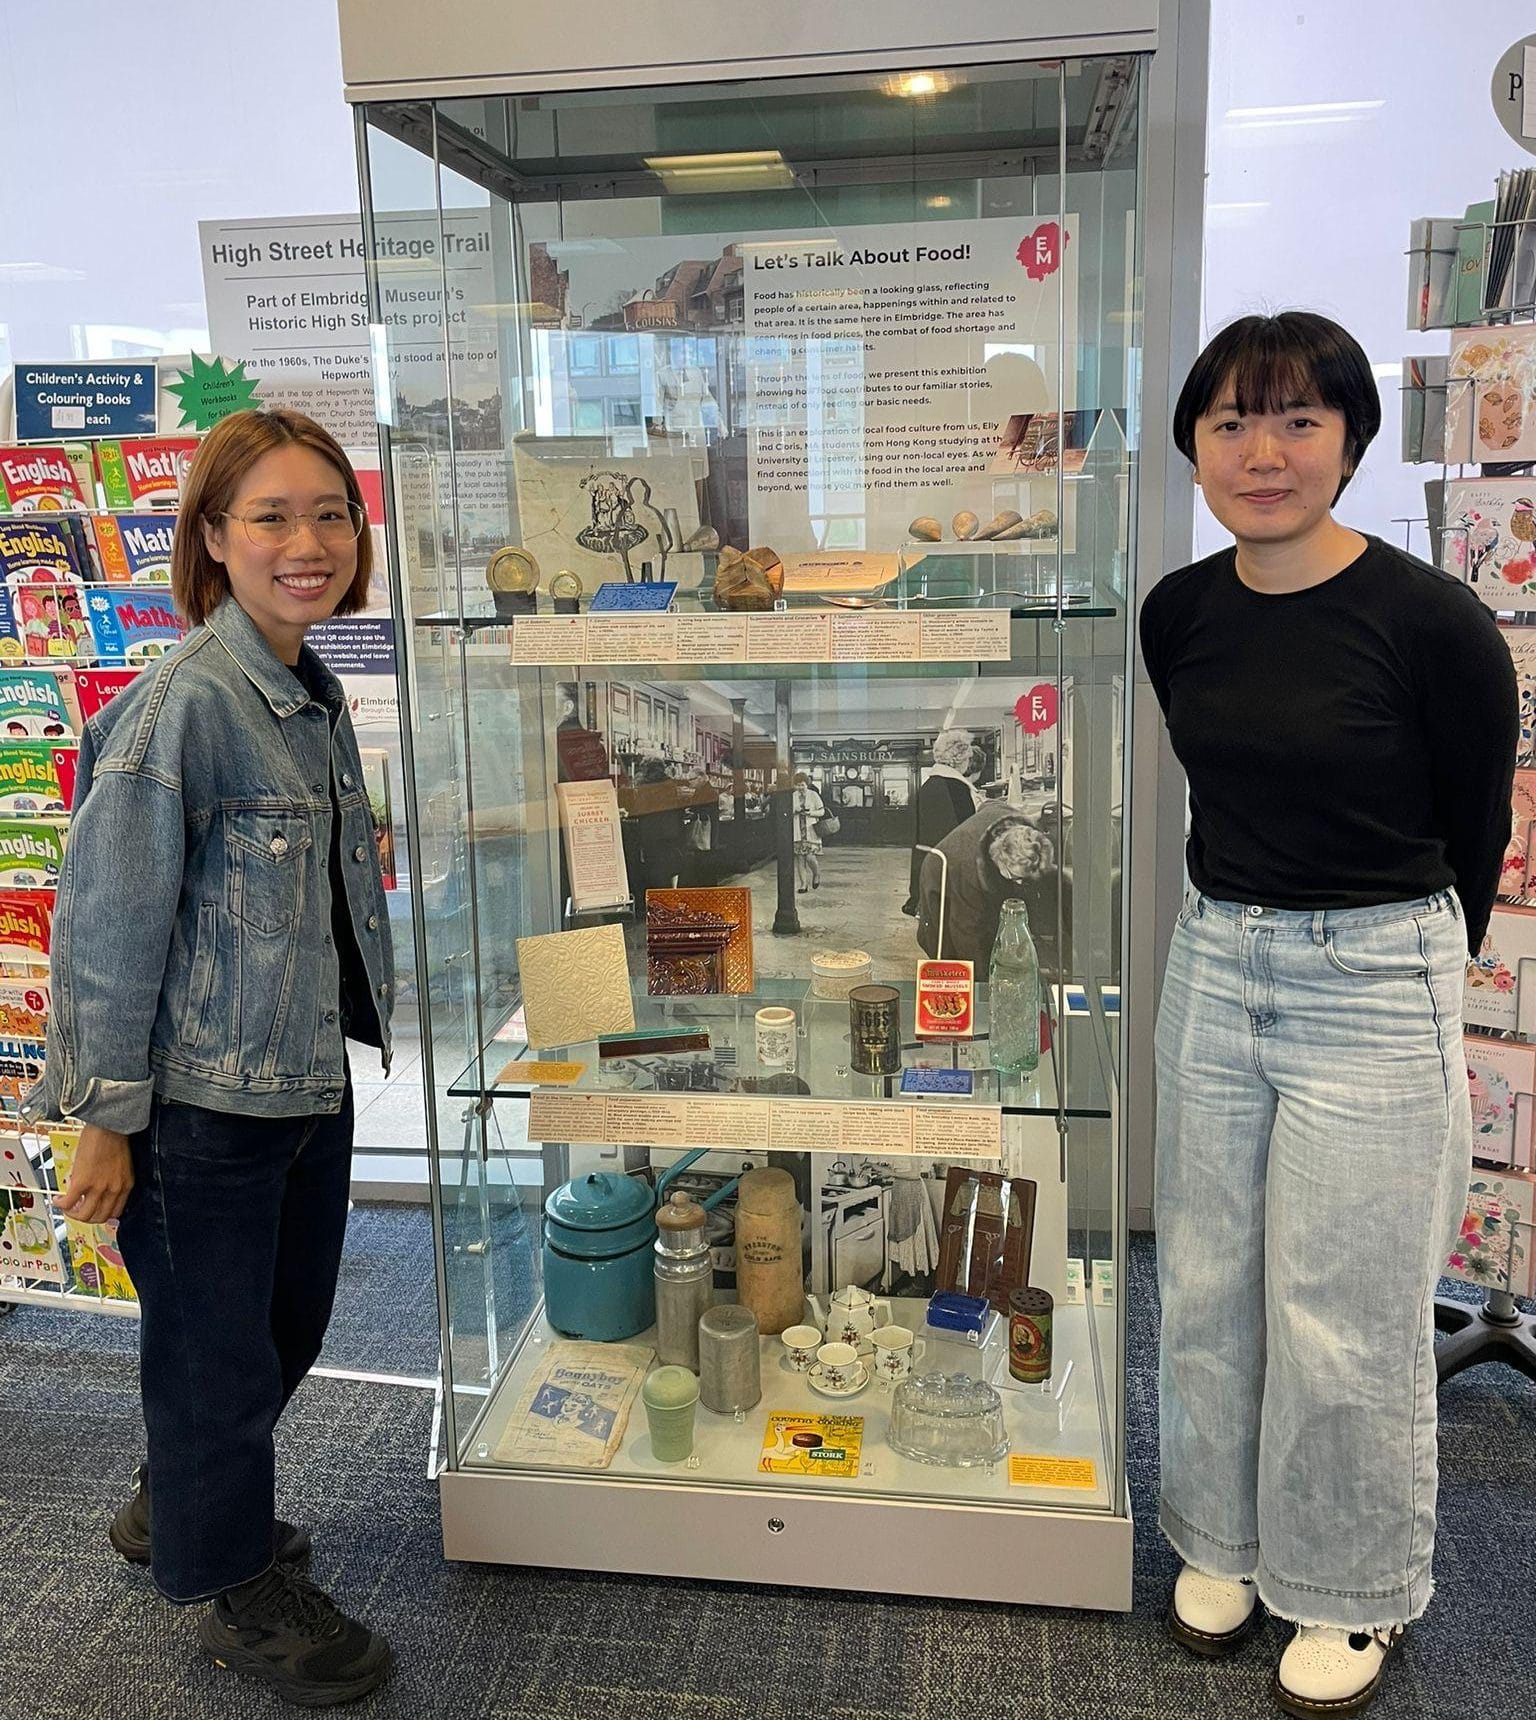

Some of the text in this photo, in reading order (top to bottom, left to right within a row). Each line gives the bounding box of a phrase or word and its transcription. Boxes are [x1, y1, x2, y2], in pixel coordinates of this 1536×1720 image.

[212, 243, 262, 268] High
[268, 240, 334, 260] Street
[442, 232, 490, 252] Trail
[754, 244, 970, 270] Let's Talk About Food!
[1461, 258, 1482, 272] LOV
[247, 287, 464, 308] Part of Elmbridg Museum's
[754, 282, 990, 300] Food looking glass, reflecting
[754, 306, 784, 316] people
[786, 304, 796, 312] of
[805, 303, 837, 312] certain
[864, 300, 917, 311] happenings
[920, 298, 948, 306] within
[950, 296, 968, 304] and
[970, 296, 1004, 304] related
[1006, 294, 1016, 302] to
[249, 316, 306, 330] Historic
[312, 314, 346, 331] High
[350, 312, 408, 326] Stets
[636, 316, 678, 328] COUSINS
[754, 320, 772, 328] that
[807, 318, 815, 326] is
[817, 317, 832, 326] the
[884, 314, 892, 322] in
[894, 312, 944, 322] Elmbridge.
[812, 330, 832, 339] food
[882, 327, 918, 336] combat
[920, 326, 929, 334] of
[932, 326, 952, 334] food
[954, 324, 995, 334] shortage
[998, 323, 1016, 331] and
[260, 350, 498, 368] the 1960s, The Duke's stood at top of
[322, 370, 370, 381] Hepworth
[884, 370, 919, 379] present
[922, 368, 938, 376] this
[940, 366, 986, 376] exhibition
[26, 372, 143, 388] Children's Activity &
[202, 380, 235, 390] Children's
[922, 382, 957, 390] familiar
[960, 380, 992, 390] stories,
[38, 392, 131, 408] Colouring Books
[302, 390, 313, 398] top
[326, 388, 360, 397] Hepworth
[876, 396, 932, 406] basic needs.
[86, 414, 111, 425] each
[886, 422, 965, 433] food culture from
[886, 436, 978, 448] Hong Kong studying
[757, 456, 800, 465] University
[903, 452, 944, 460] non-local
[2, 457, 72, 485] English
[758, 470, 774, 478] find
[872, 466, 892, 474] food
[894, 465, 902, 474] in
[905, 464, 920, 473] the
[922, 464, 944, 472] local
[968, 464, 985, 472] and
[758, 478, 954, 492] beyond, find them well.
[0, 532, 68, 558] English
[124, 527, 173, 556] Mat
[96, 680, 128, 694] Lear
[820, 751, 895, 761] SAINSBURY
[0, 758, 60, 784] nglish
[0, 834, 58, 860] nglish
[0, 911, 42, 938] glish
[36, 1260, 58, 1272] Pad
[770, 1416, 814, 1424] COUNTRY
[810, 1450, 844, 1459] STORK
